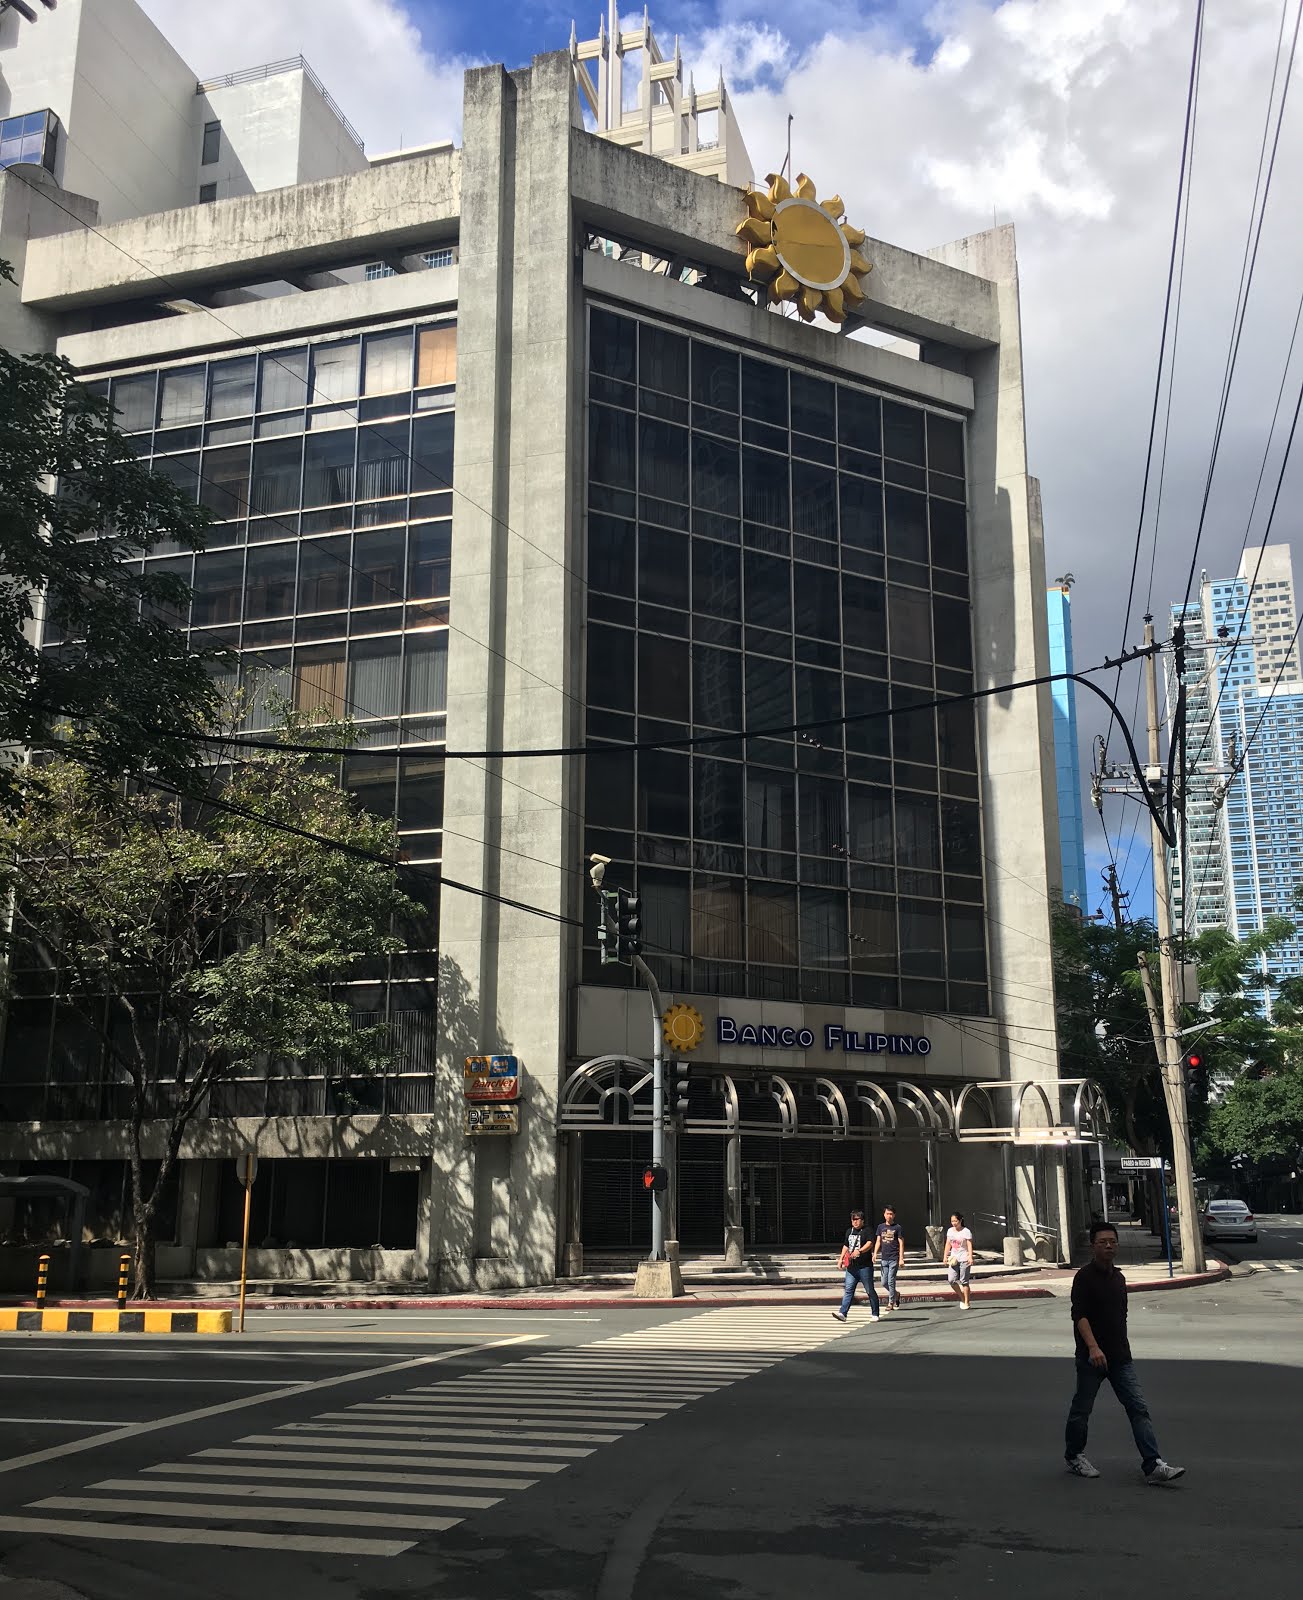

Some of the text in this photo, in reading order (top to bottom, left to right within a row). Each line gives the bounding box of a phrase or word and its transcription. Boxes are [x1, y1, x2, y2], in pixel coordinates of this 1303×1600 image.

[471, 1061, 488, 1073] BF
[472, 1078, 514, 1088] BancNet
[468, 1110, 491, 1124] BF
